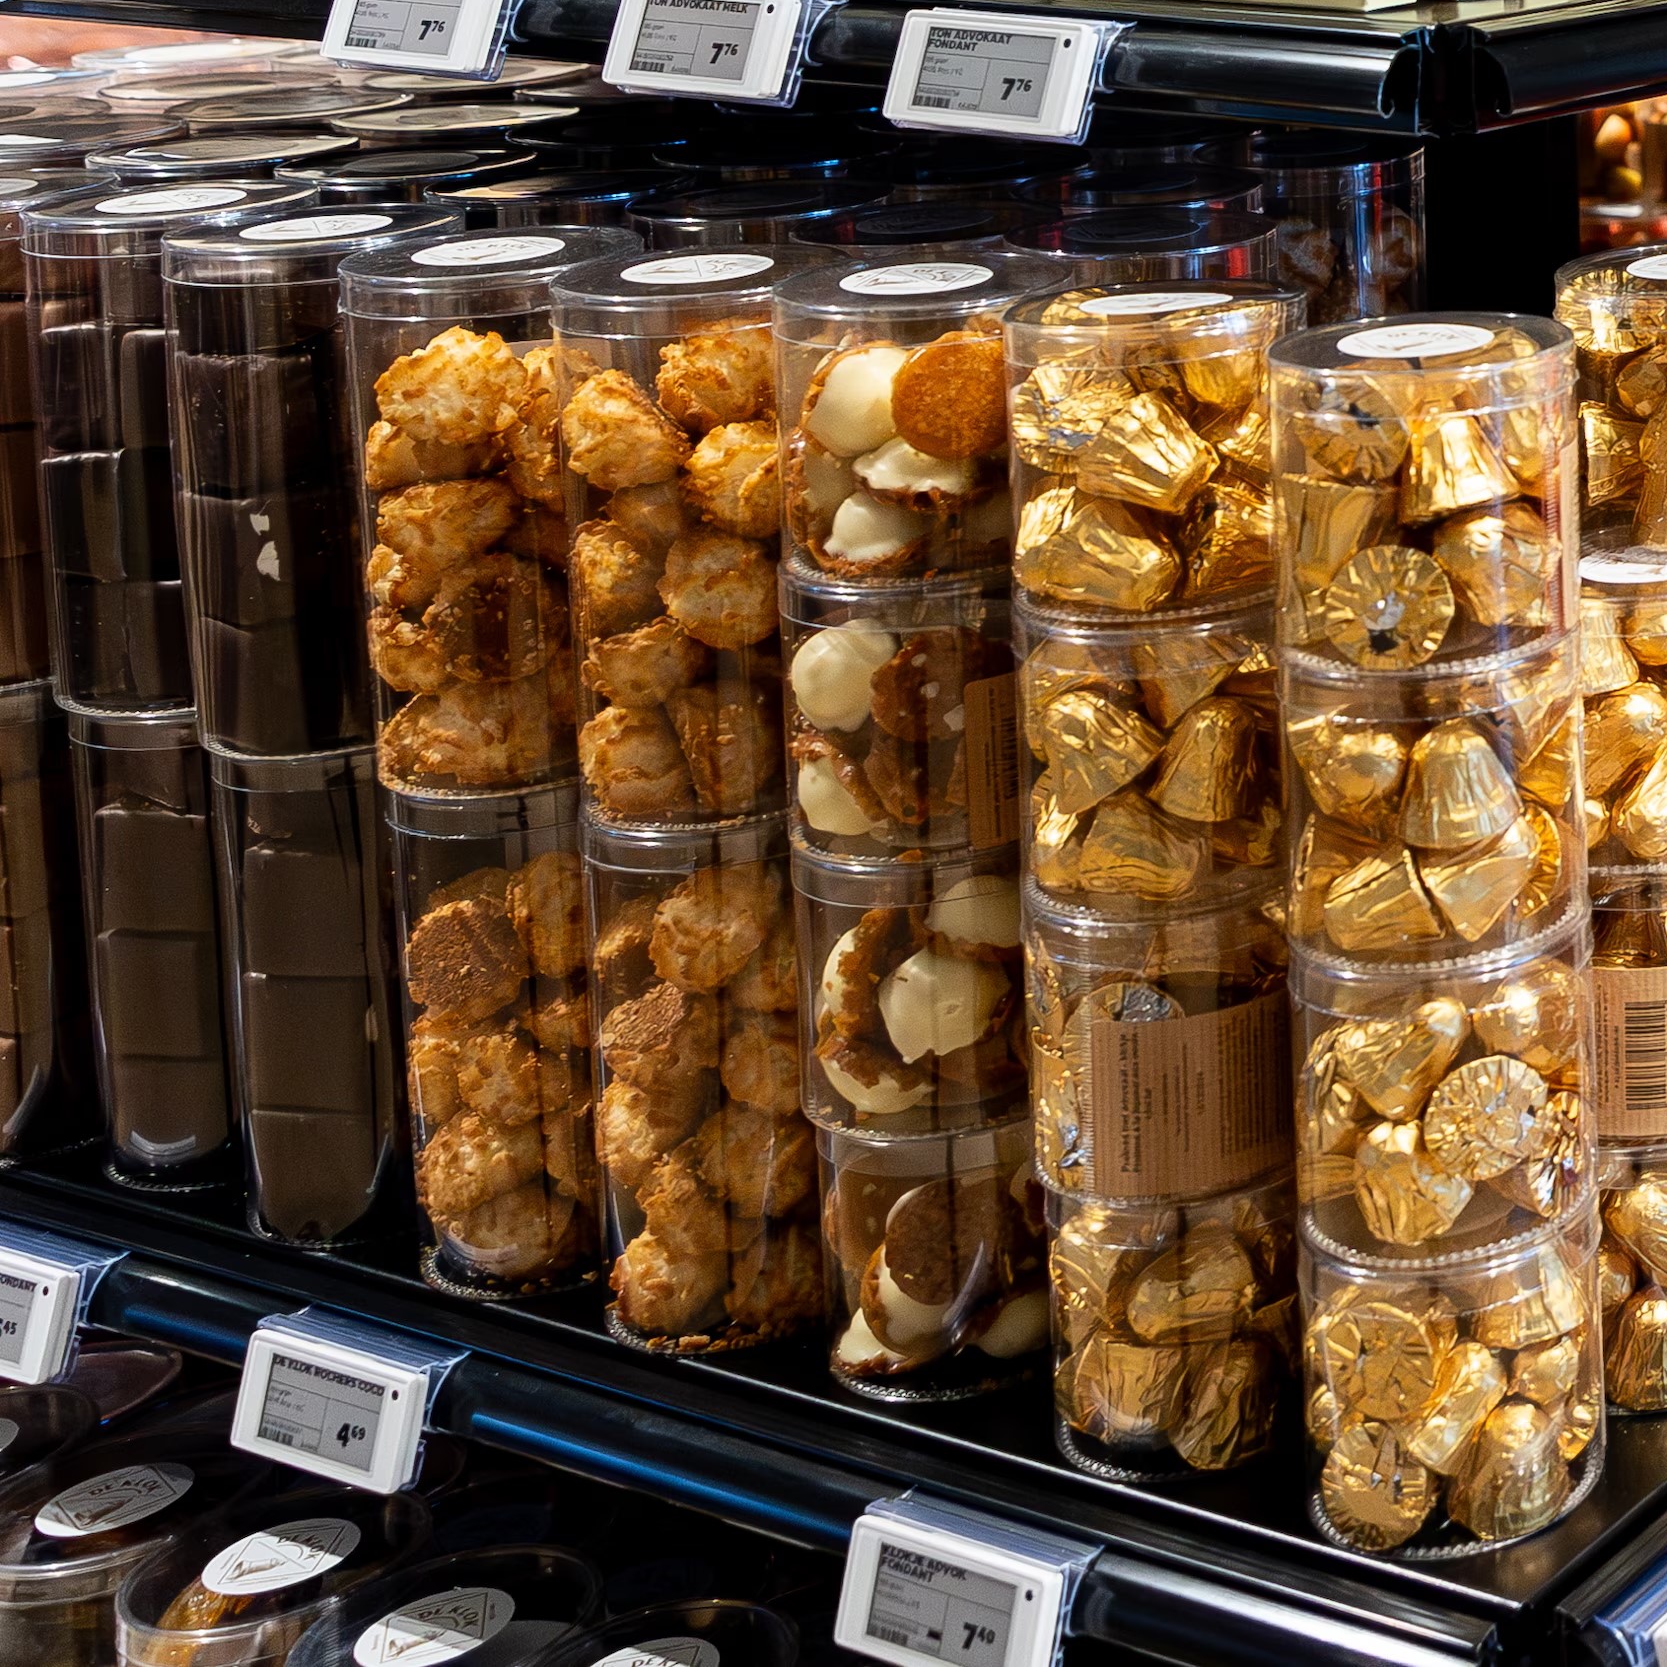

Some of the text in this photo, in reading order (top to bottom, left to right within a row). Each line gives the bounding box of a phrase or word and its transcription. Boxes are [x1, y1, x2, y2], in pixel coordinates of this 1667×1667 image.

[721, 3, 749, 14] MELK
[928, 38, 978, 52] FONDANT
[930, 26, 1012, 45] TON ADVOKAAT
[273, 1354, 385, 1397] DE KLOK ROCHERS COCO
[881, 1556, 935, 1583] FONDANT
[927, 1558, 968, 1581] ADVOK
[448, 1605, 479, 1629] KLOK
